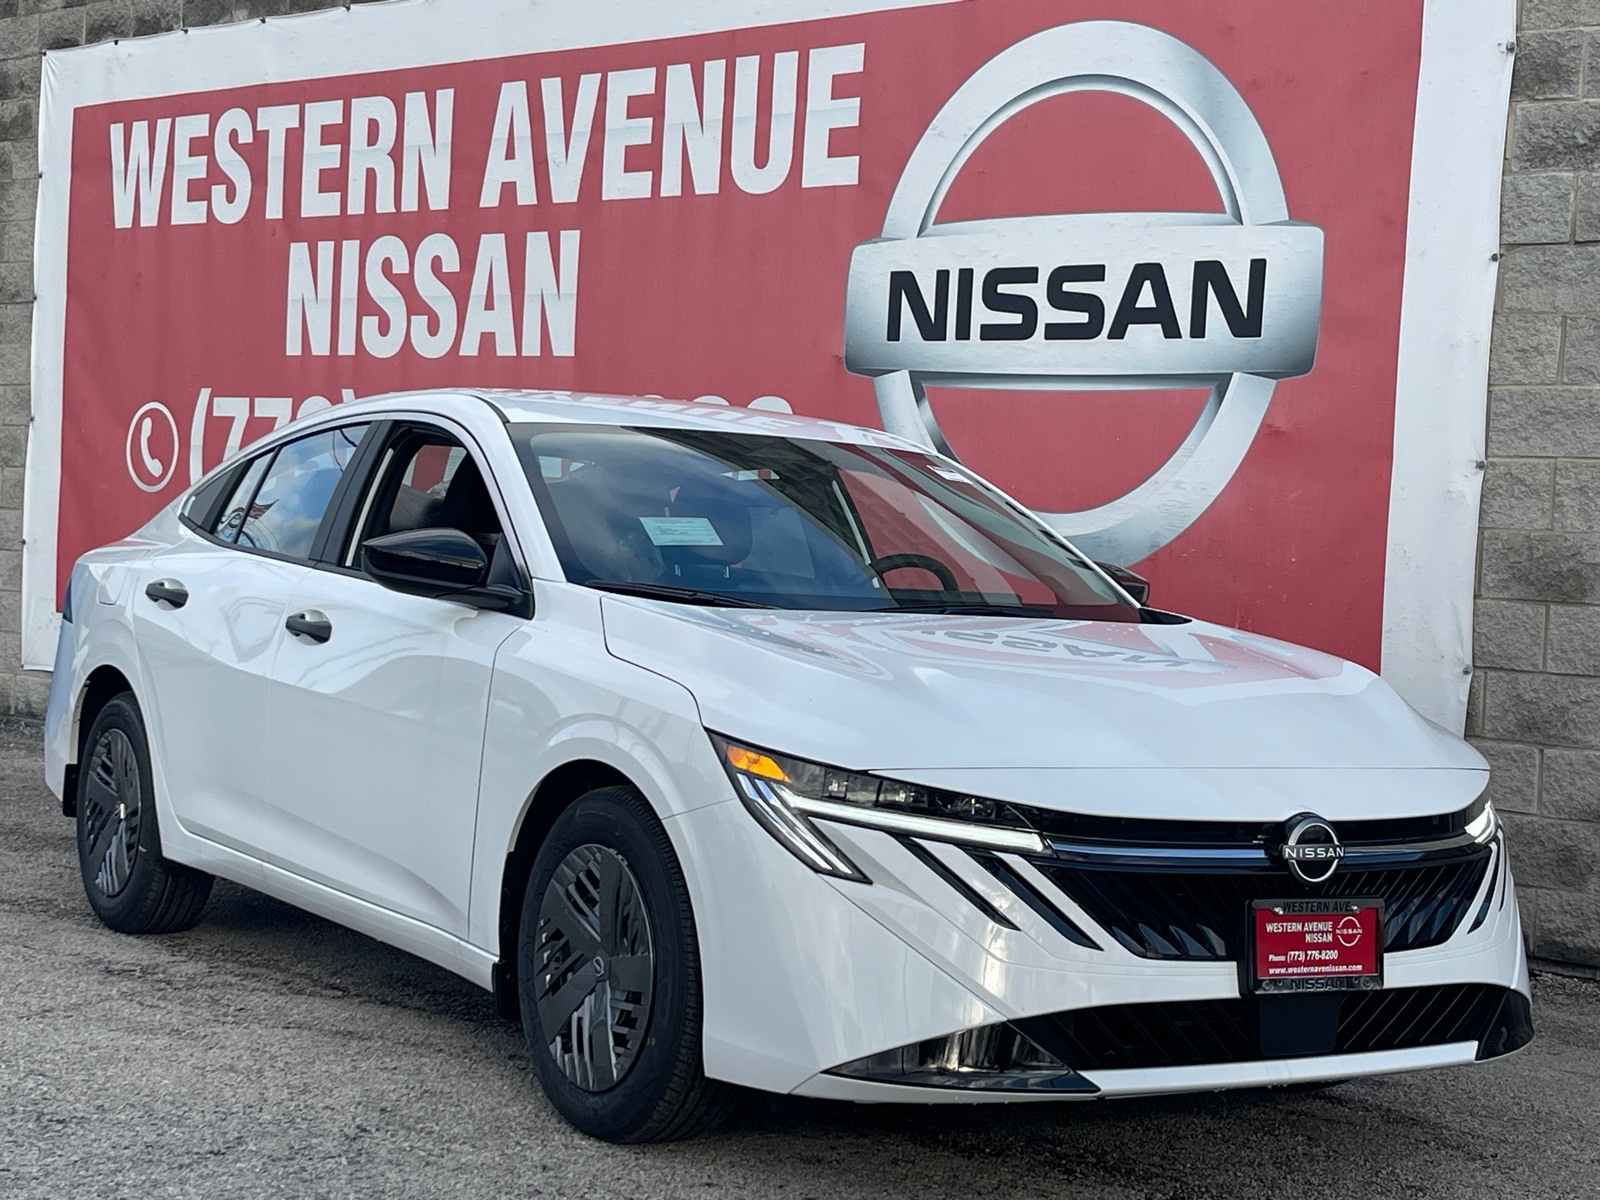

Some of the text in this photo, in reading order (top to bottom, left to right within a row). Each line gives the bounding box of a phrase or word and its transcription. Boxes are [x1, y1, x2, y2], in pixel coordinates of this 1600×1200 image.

[109, 42, 866, 229] WESTERN AVENUE
[286, 230, 580, 358] NISSAN
[887, 258, 1267, 342] NISSAN
[1285, 846, 1345, 859] NISSAN
[1283, 901, 1329, 913] WESTERN
[1266, 921, 1333, 933] WESTERN AVENUE
[1305, 932, 1333, 943] NISSAN
[1268, 950, 1338, 963] Phone: (773) 776-8200
[1269, 964, 1362, 974] www.westernavenissan.com
[1291, 978, 1347, 991] NISSAN
